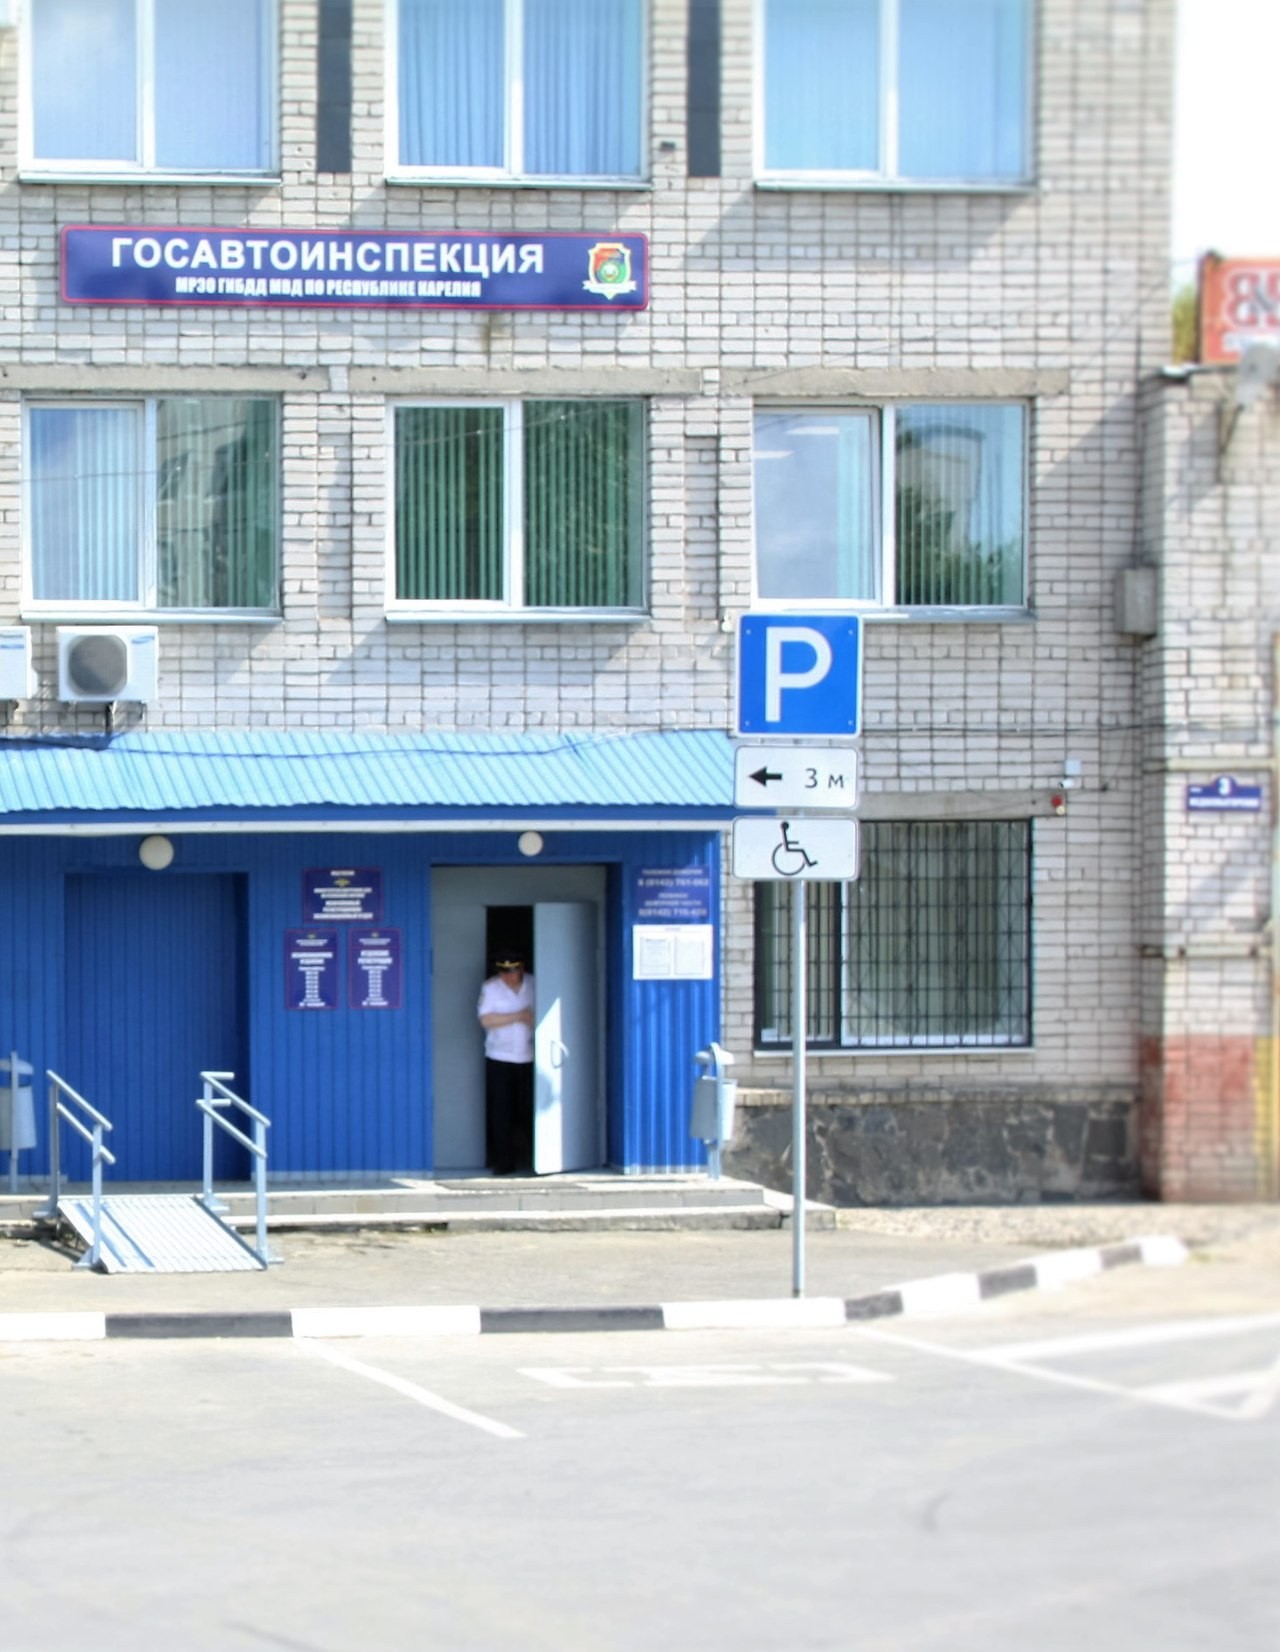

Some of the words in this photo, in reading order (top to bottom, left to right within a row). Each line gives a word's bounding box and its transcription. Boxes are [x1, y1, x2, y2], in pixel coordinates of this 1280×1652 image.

[111, 237, 545, 279] ГОСАВТОИНСПЕКЦИЯ
[218, 277, 268, 296] ГИБДД
[269, 278, 304, 297] МВД
[304, 279, 326, 296] ПО
[326, 279, 417, 297] РЕСПУБЛИКЕ
[417, 281, 482, 298] КАРЕЛИЯ
[764, 626, 833, 723] P
[804, 767, 818, 789] 3
